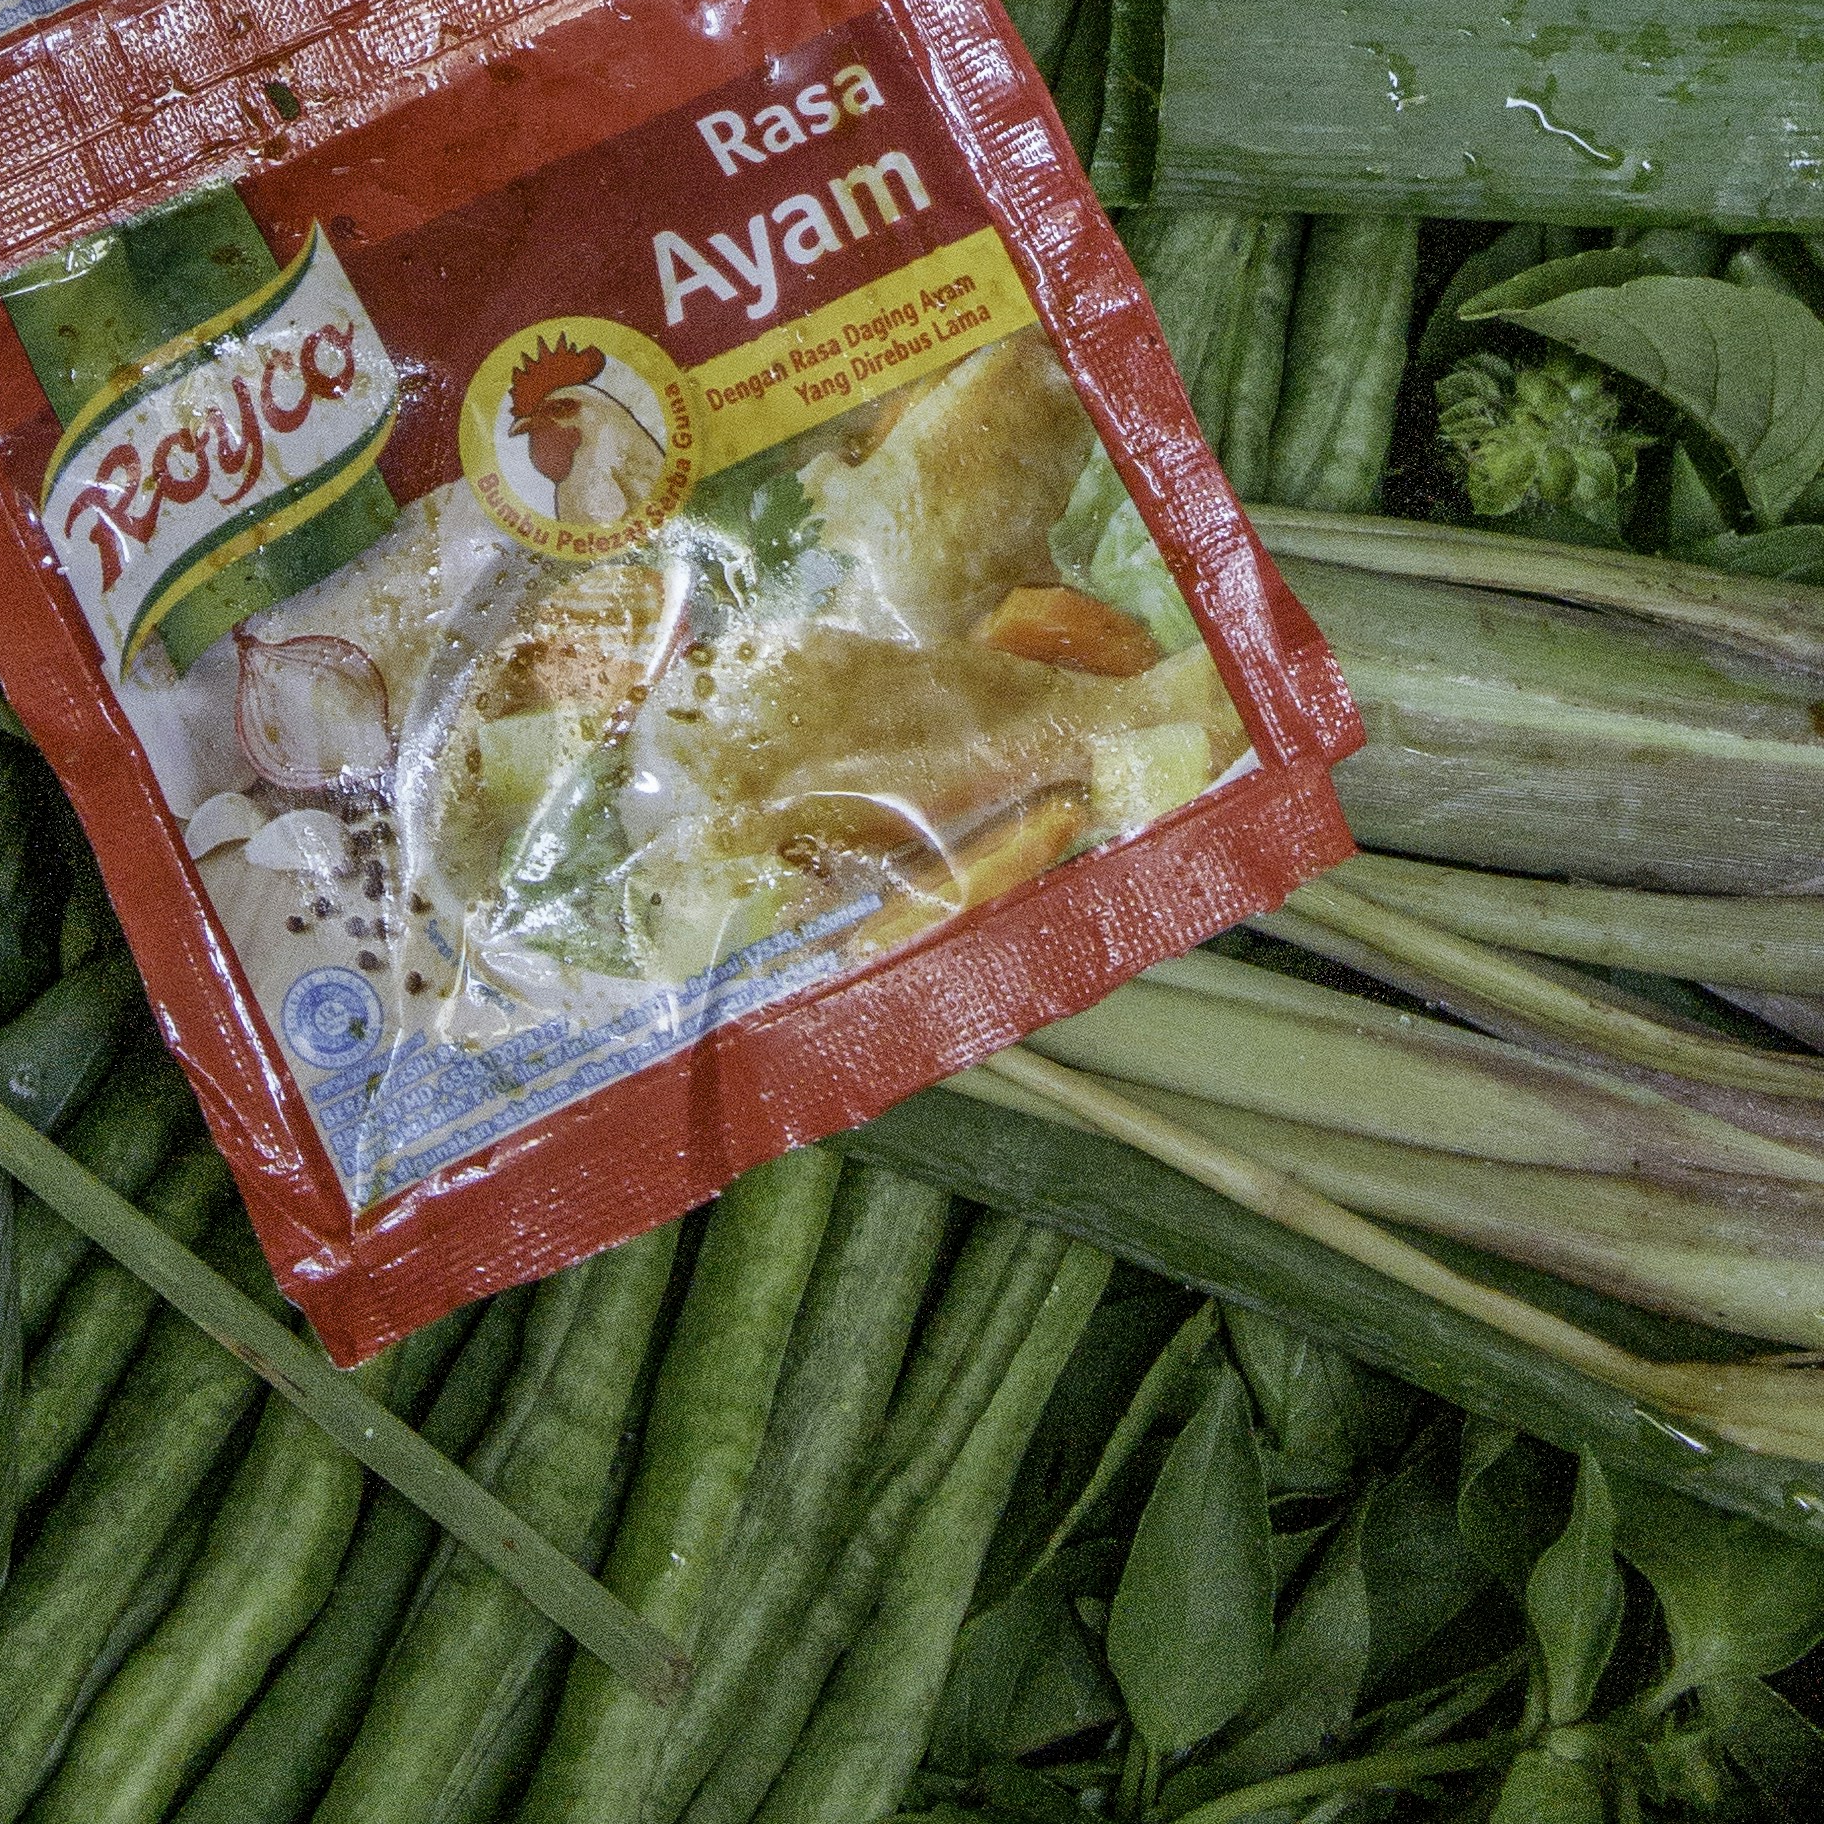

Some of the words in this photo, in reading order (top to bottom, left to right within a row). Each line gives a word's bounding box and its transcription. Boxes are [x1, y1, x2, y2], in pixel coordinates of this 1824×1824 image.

[696, 63, 885, 177] Rasa
[652, 150, 931, 327] Ayam
[705, 363, 789, 412] Dengan
[788, 337, 841, 374] Rasa
[842, 301, 920, 348] Daging
[919, 274, 976, 313] Ayam
[793, 370, 852, 406] Yang
[850, 333, 934, 382] Direbus
[932, 303, 992, 341] Lama
[64, 320, 356, 594] Royco
[664, 381, 693, 450] Guna
[477, 472, 550, 546] Bumbu
[645, 457, 692, 528] Serba
[319, 1085, 374, 1129] BERA
[580, 1053, 626, 1088] lihat
